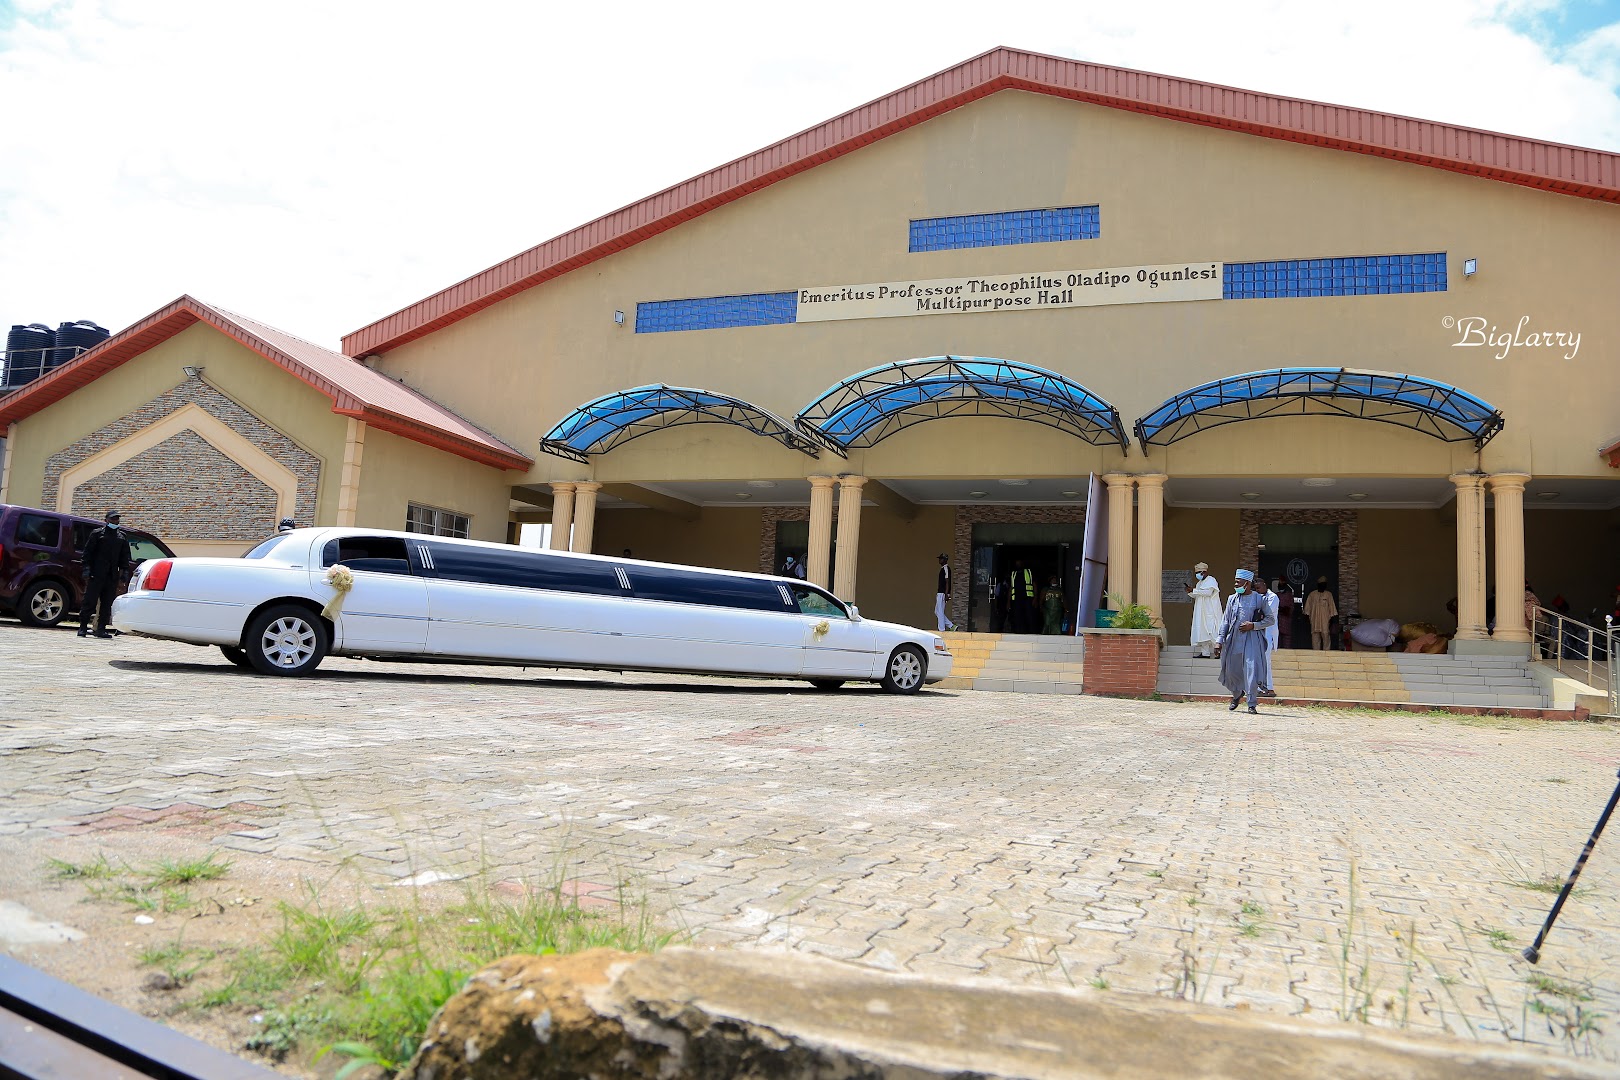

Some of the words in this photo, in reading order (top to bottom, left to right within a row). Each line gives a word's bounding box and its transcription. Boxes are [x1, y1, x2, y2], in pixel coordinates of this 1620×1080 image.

[800, 288, 875, 304] Emeritus
[878, 284, 963, 298] Professor
[967, 276, 1062, 293] Theophilus
[1066, 271, 1130, 288] Oladipo
[1136, 264, 1218, 289] Ogunlesi
[916, 296, 1032, 311] Multipurpose
[1037, 289, 1074, 305] Hall
